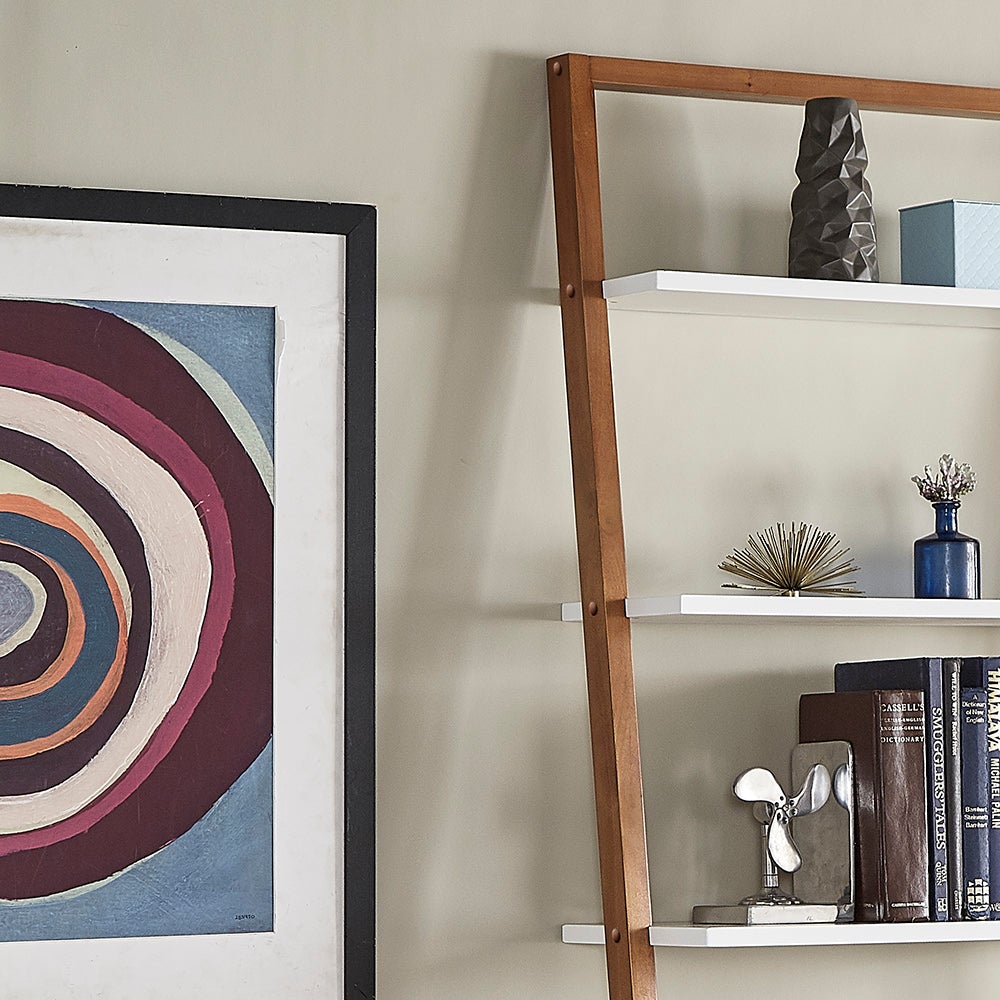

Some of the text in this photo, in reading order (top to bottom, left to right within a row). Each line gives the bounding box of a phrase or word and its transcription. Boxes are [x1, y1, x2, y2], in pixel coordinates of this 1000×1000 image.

[880, 736, 924, 744] DICTIONARY
[987, 668, 1000, 829] HIMALAYA MICHAEL PALIN
[935, 806, 946, 850] TALES
